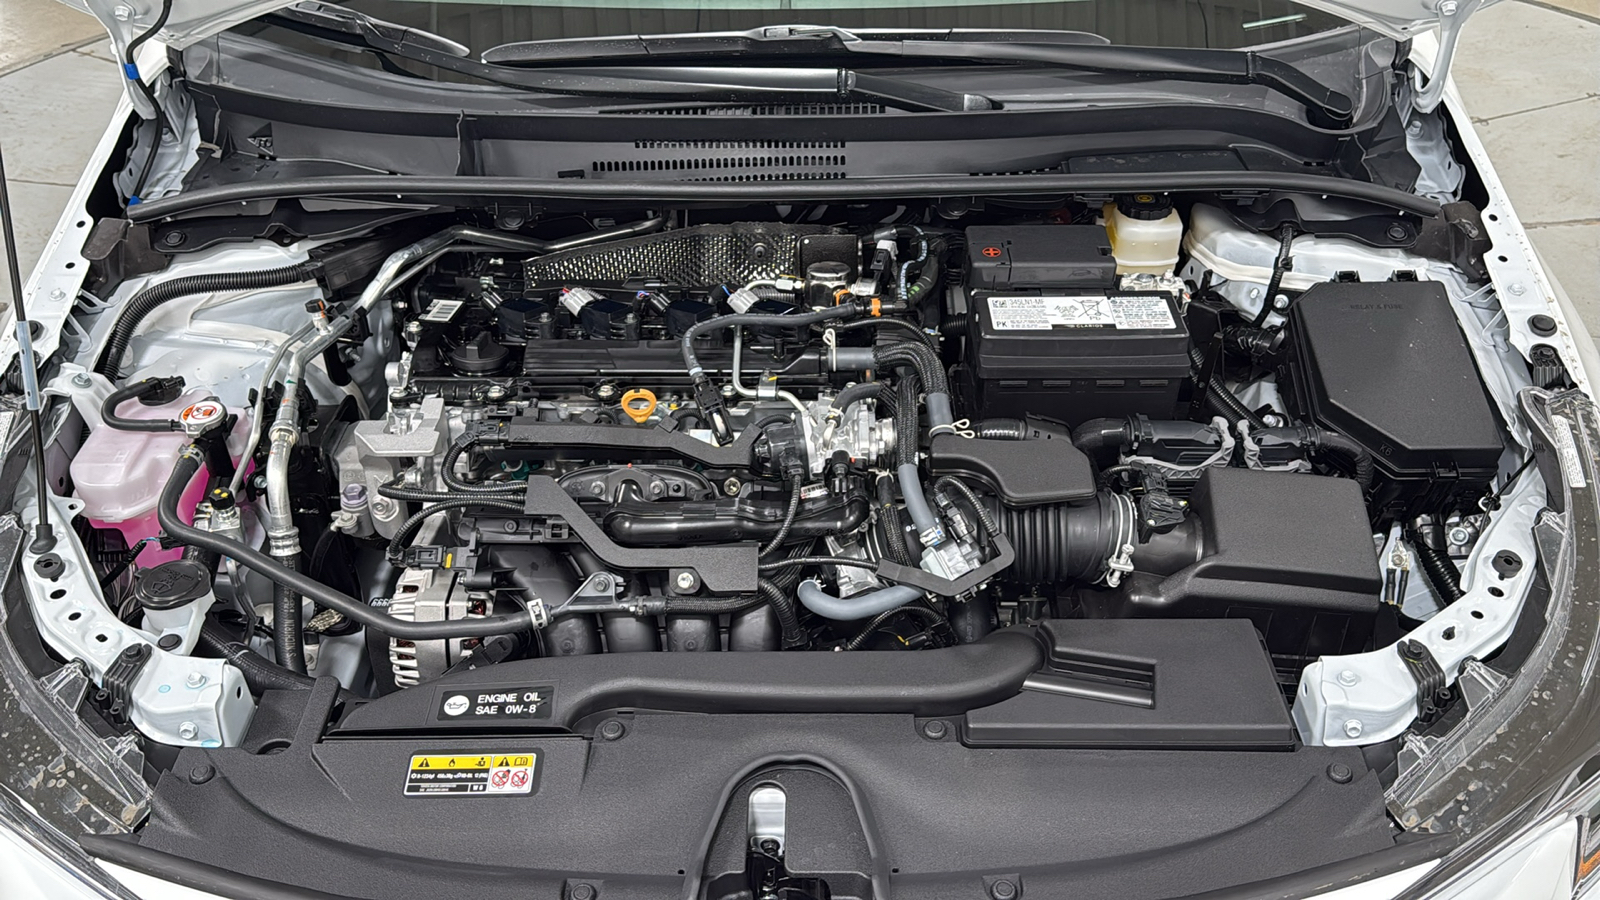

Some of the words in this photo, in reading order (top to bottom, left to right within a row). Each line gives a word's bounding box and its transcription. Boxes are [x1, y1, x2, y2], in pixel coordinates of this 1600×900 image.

[477, 693, 518, 703] ENGINE
[523, 692, 541, 702] OIL
[475, 705, 499, 715] SAE
[505, 704, 537, 714] 0W-8
